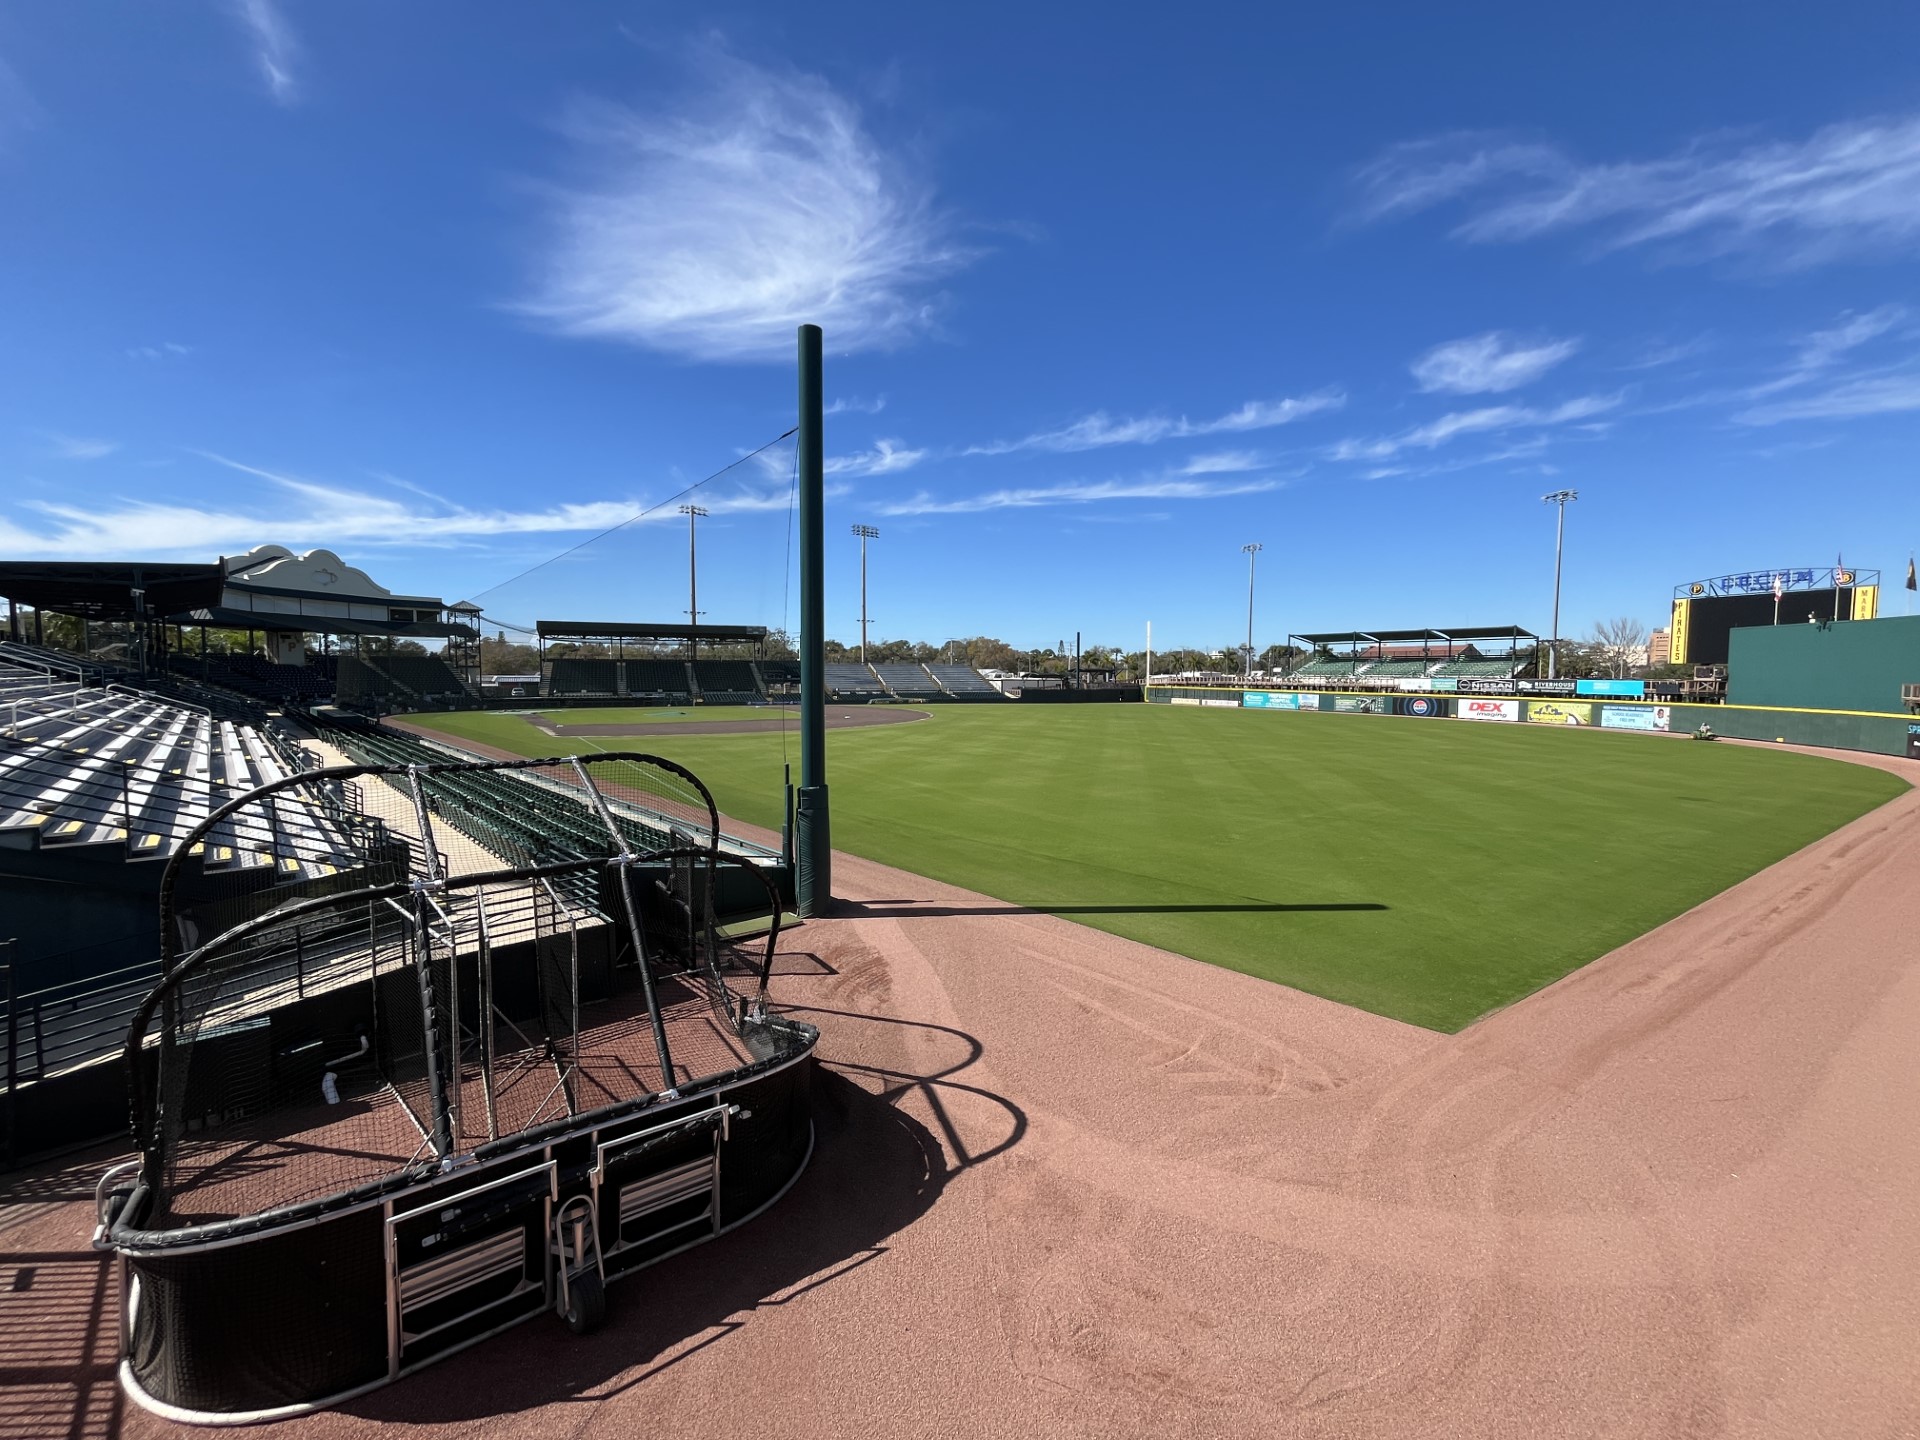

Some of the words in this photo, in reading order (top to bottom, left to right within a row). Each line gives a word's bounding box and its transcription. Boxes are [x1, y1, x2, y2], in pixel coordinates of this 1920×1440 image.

[1693, 584, 1701, 593] P
[1675, 602, 1683, 661] PIRATES
[1472, 682, 1513, 690] NISSAN
[1468, 702, 1504, 712] DEX
